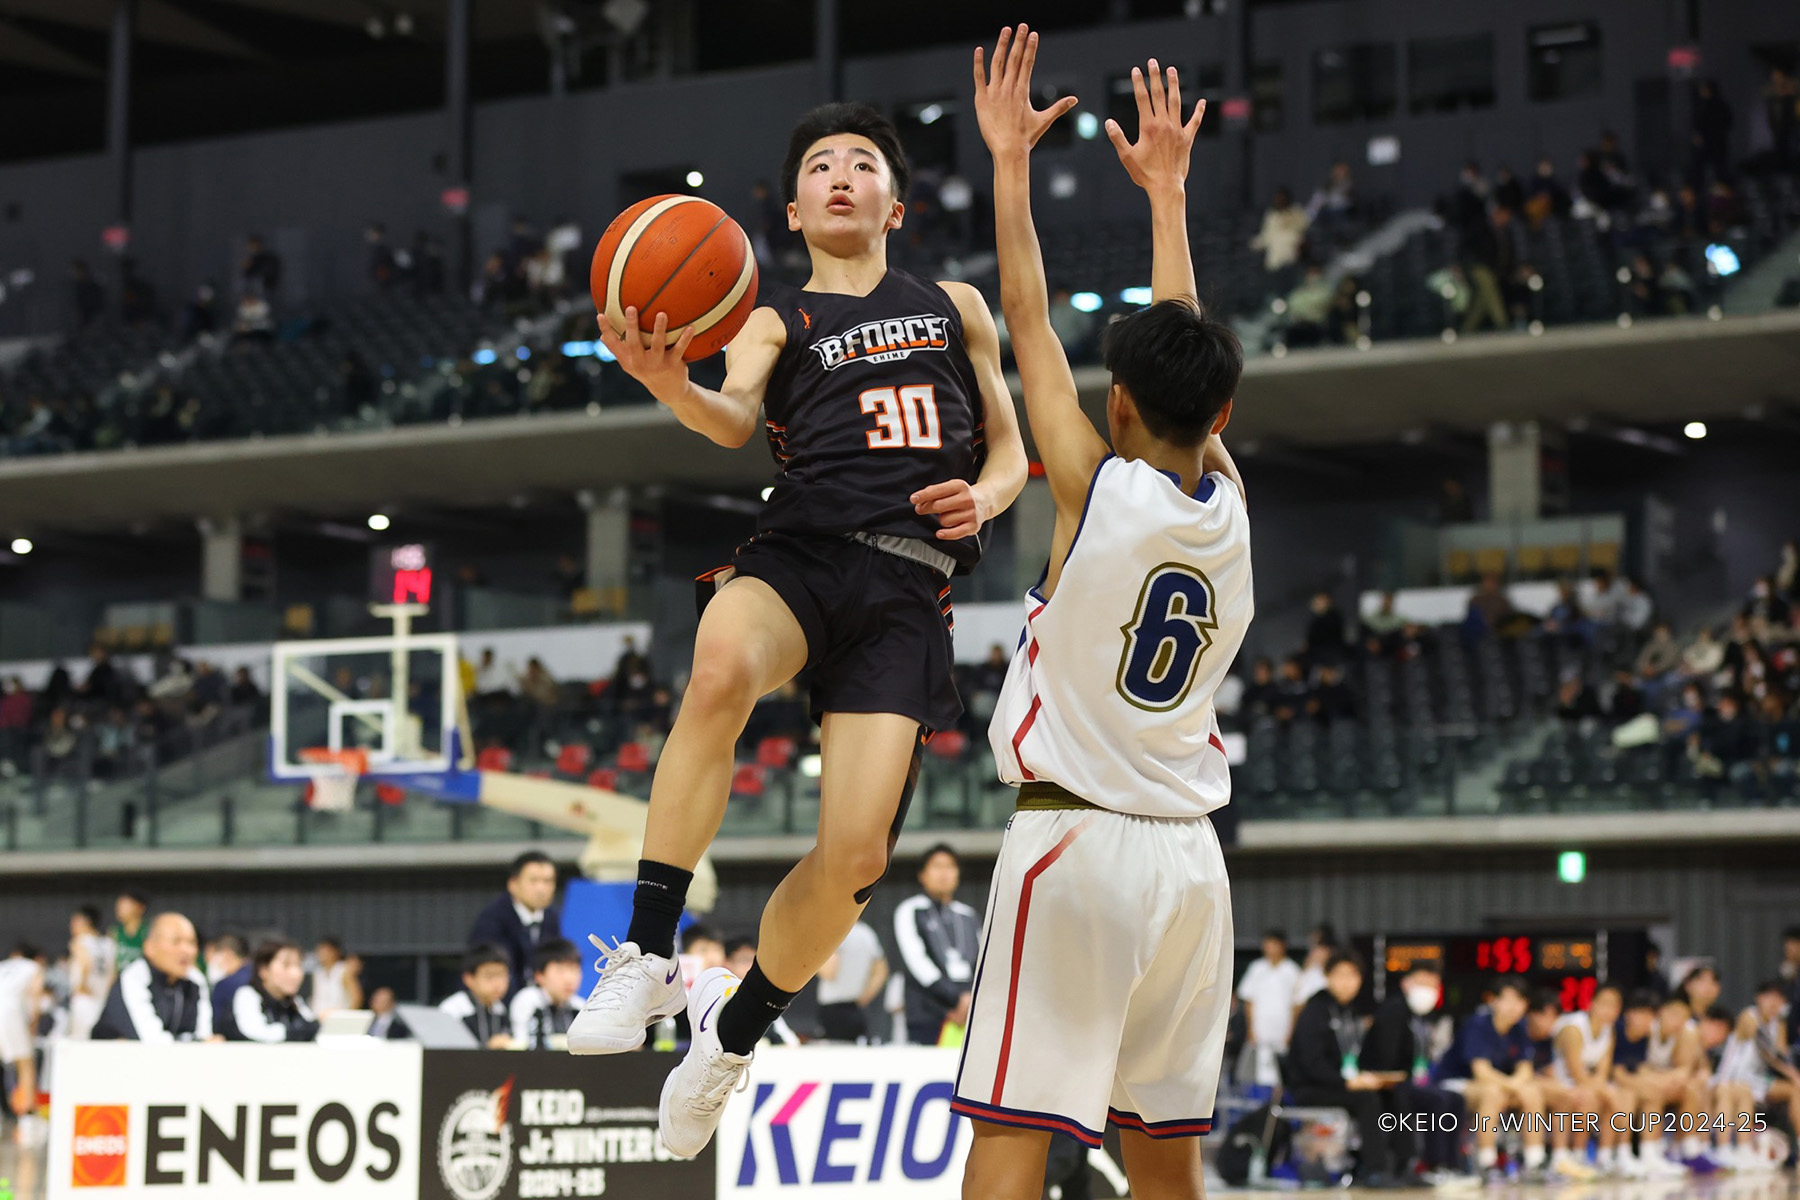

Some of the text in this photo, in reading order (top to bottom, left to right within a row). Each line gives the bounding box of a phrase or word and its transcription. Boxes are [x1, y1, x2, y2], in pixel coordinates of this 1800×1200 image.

[873, 351, 905, 362] EHIME
[858, 384, 942, 449] 30
[1116, 562, 1218, 712] 6
[144, 1101, 401, 1186] ENEOS
[520, 1089, 584, 1125] KEIO
[736, 1081, 961, 1187] KEIO
